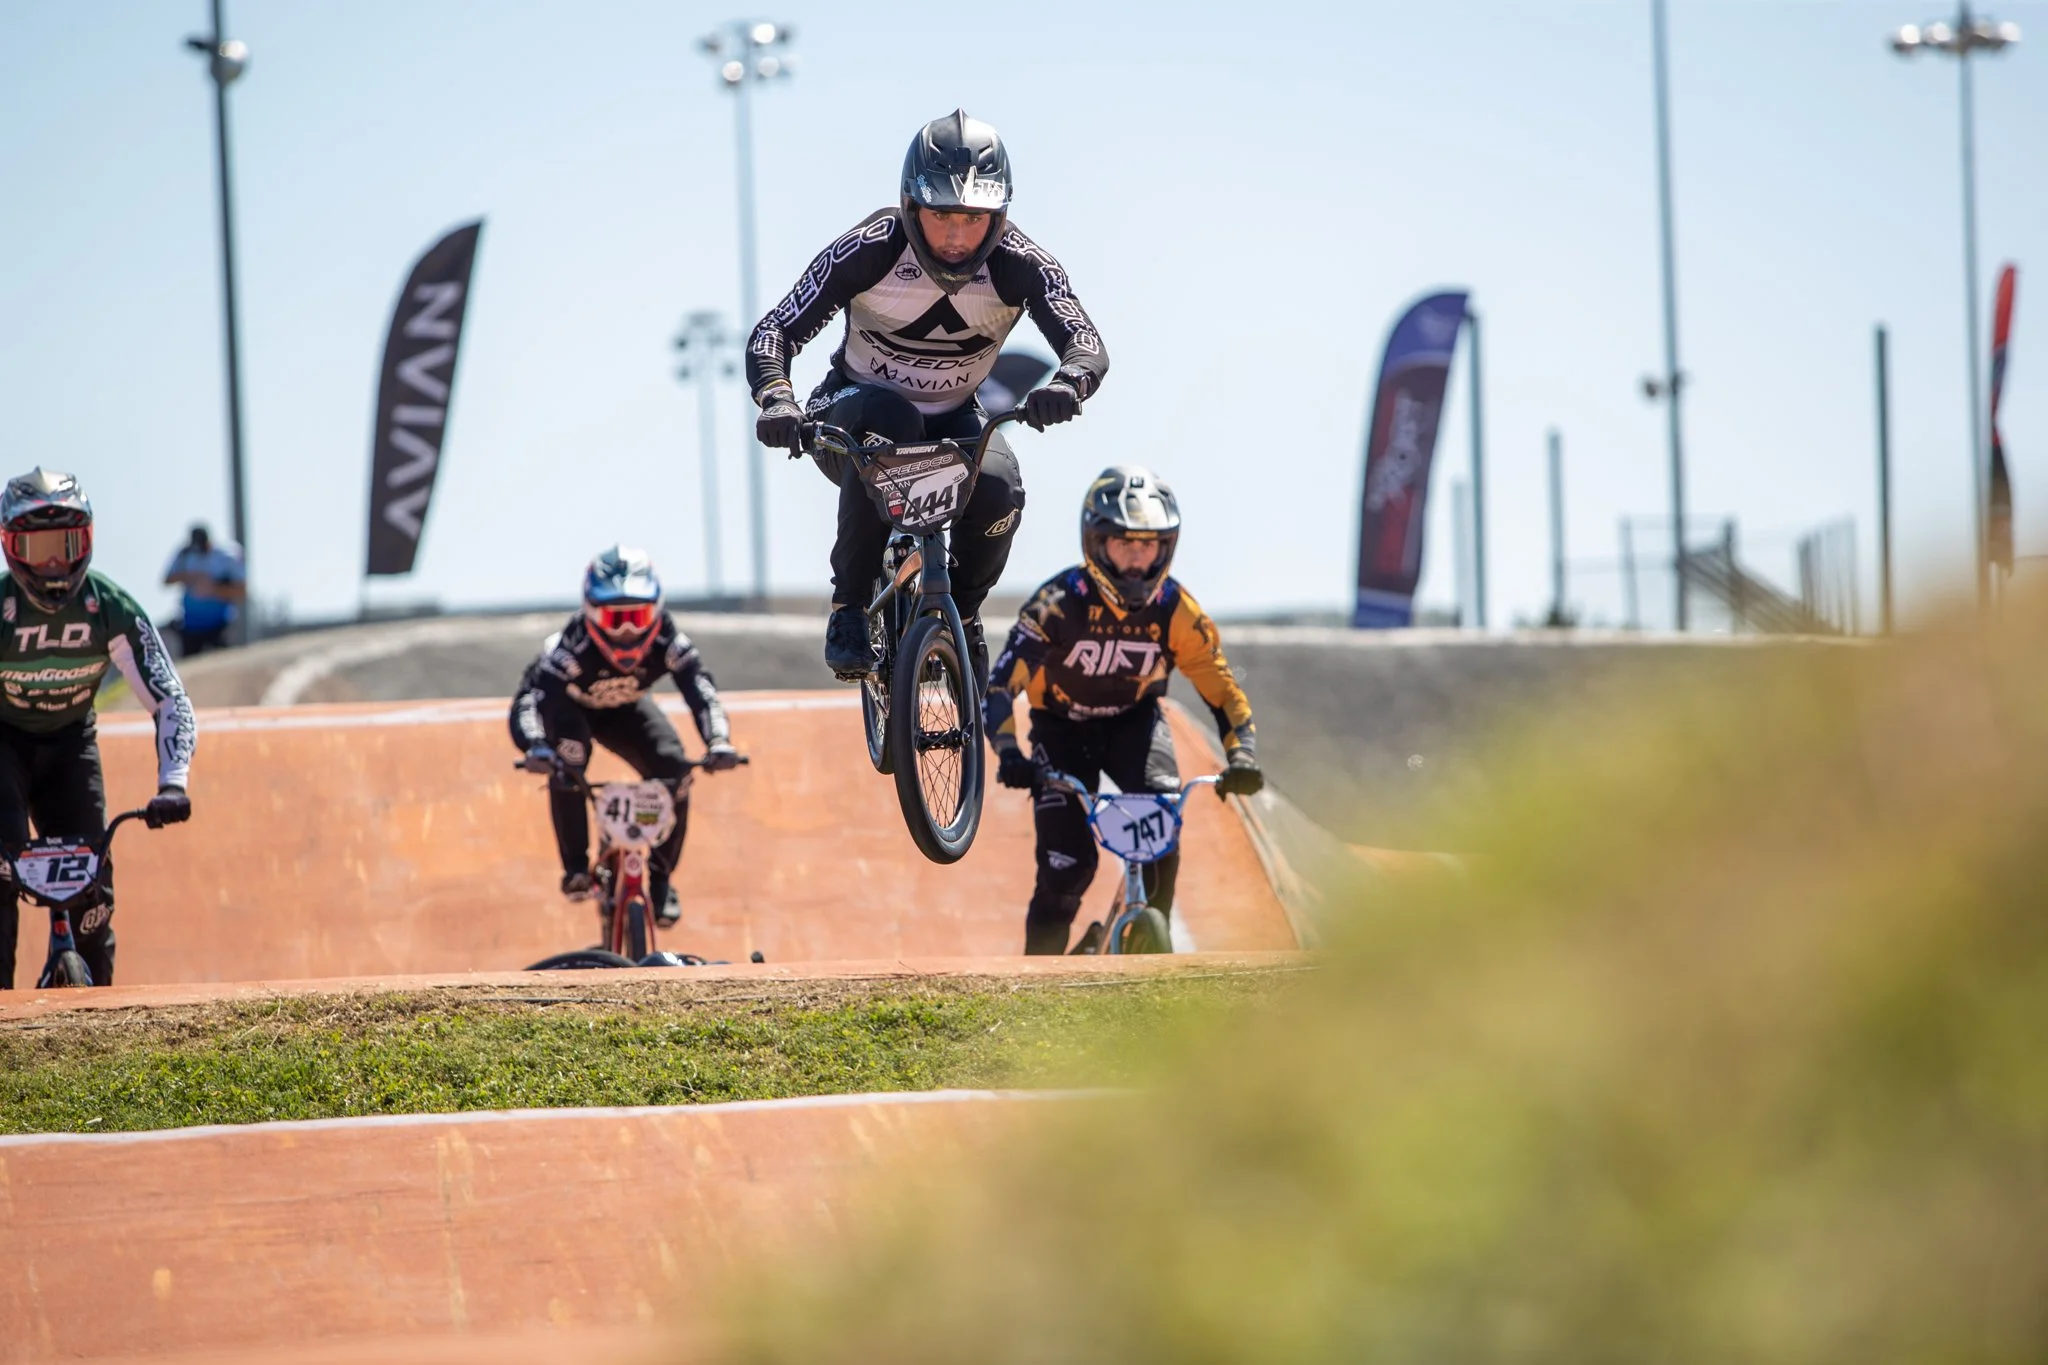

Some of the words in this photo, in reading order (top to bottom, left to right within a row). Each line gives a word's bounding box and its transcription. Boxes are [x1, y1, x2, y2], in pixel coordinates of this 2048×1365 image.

[859, 330, 998, 370] SPEEDCO
[900, 373, 971, 390] AVIAN
[383, 281, 464, 541] AVIAN
[896, 446, 939, 455] TANGENT
[876, 454, 954, 481] SPEEDCO
[904, 484, 954, 521] 444
[14, 622, 92, 652] TLD
[1063, 640, 1161, 677] RIFT
[604, 796, 631, 823] 41
[1123, 811, 1166, 850] 747
[46, 855, 90, 883] 12
